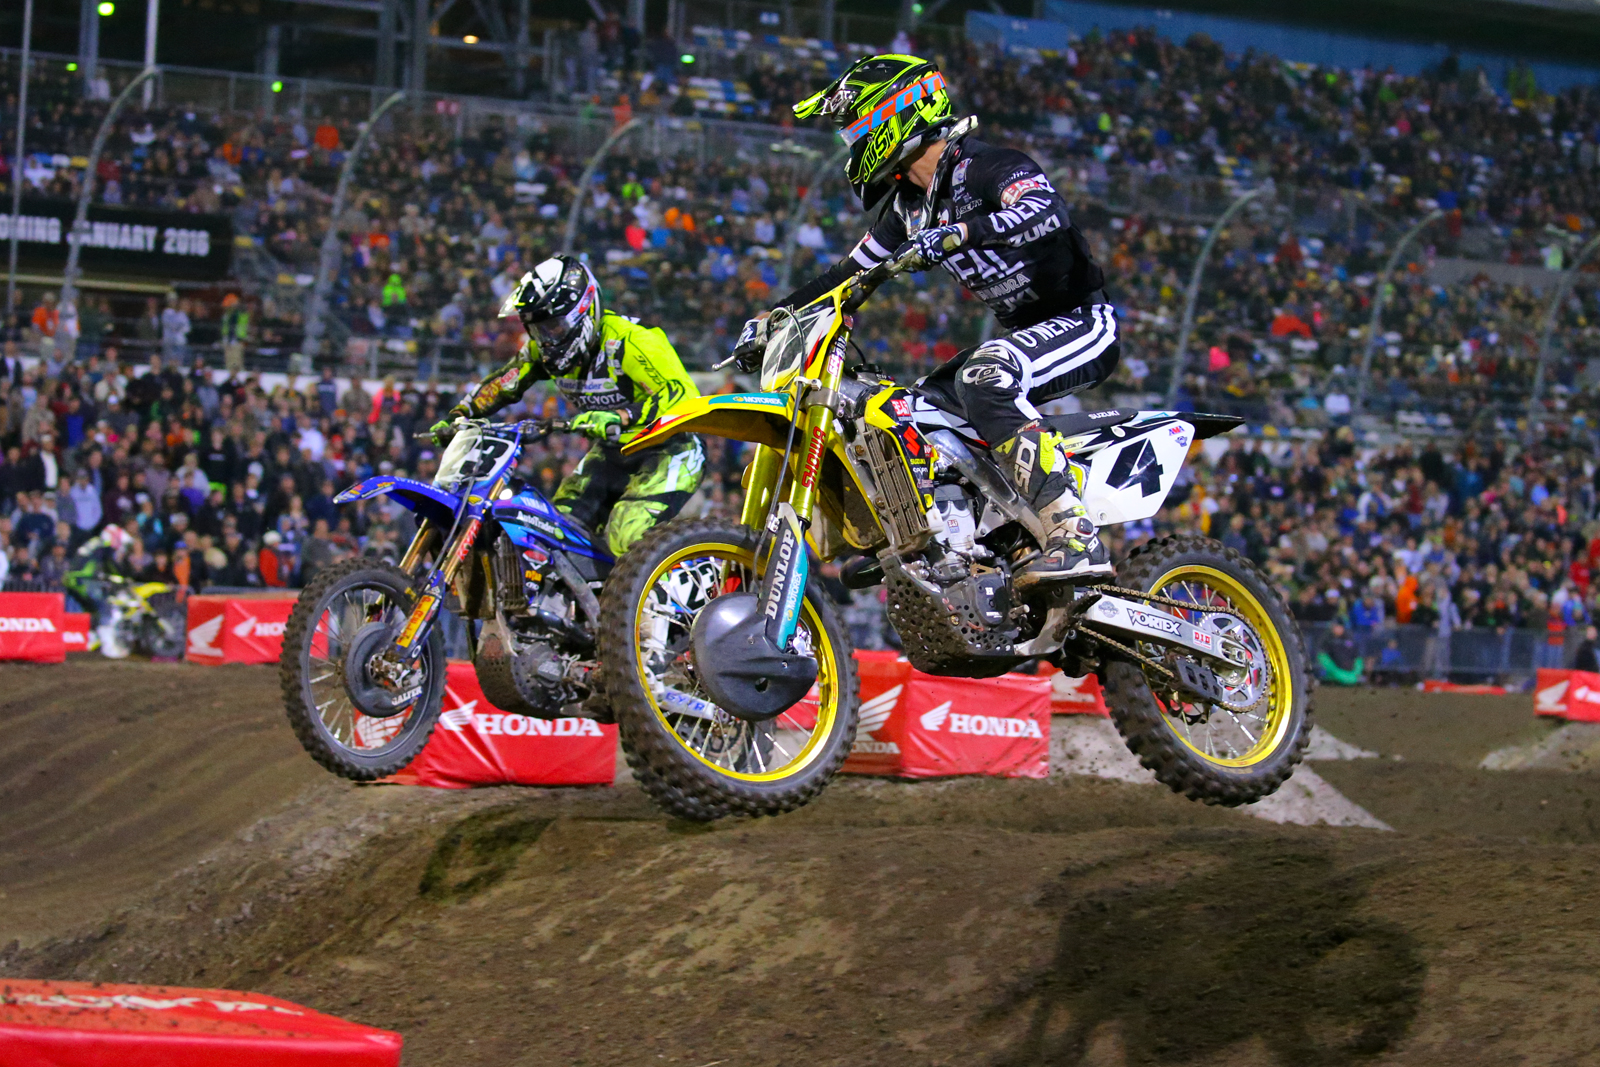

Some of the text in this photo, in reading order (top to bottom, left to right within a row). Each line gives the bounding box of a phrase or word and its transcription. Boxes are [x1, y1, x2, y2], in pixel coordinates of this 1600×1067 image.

[1012, 316, 1083, 348] O'NEAL
[743, 396, 784, 406] MOTOREX
[1087, 409, 1121, 420] SUZUKI
[1105, 437, 1164, 498] 4
[764, 528, 797, 621] DUNLOP
[1126, 607, 1182, 637] VORTEX
[475, 713, 604, 737] HONDA
[949, 712, 1043, 739] HONDA
